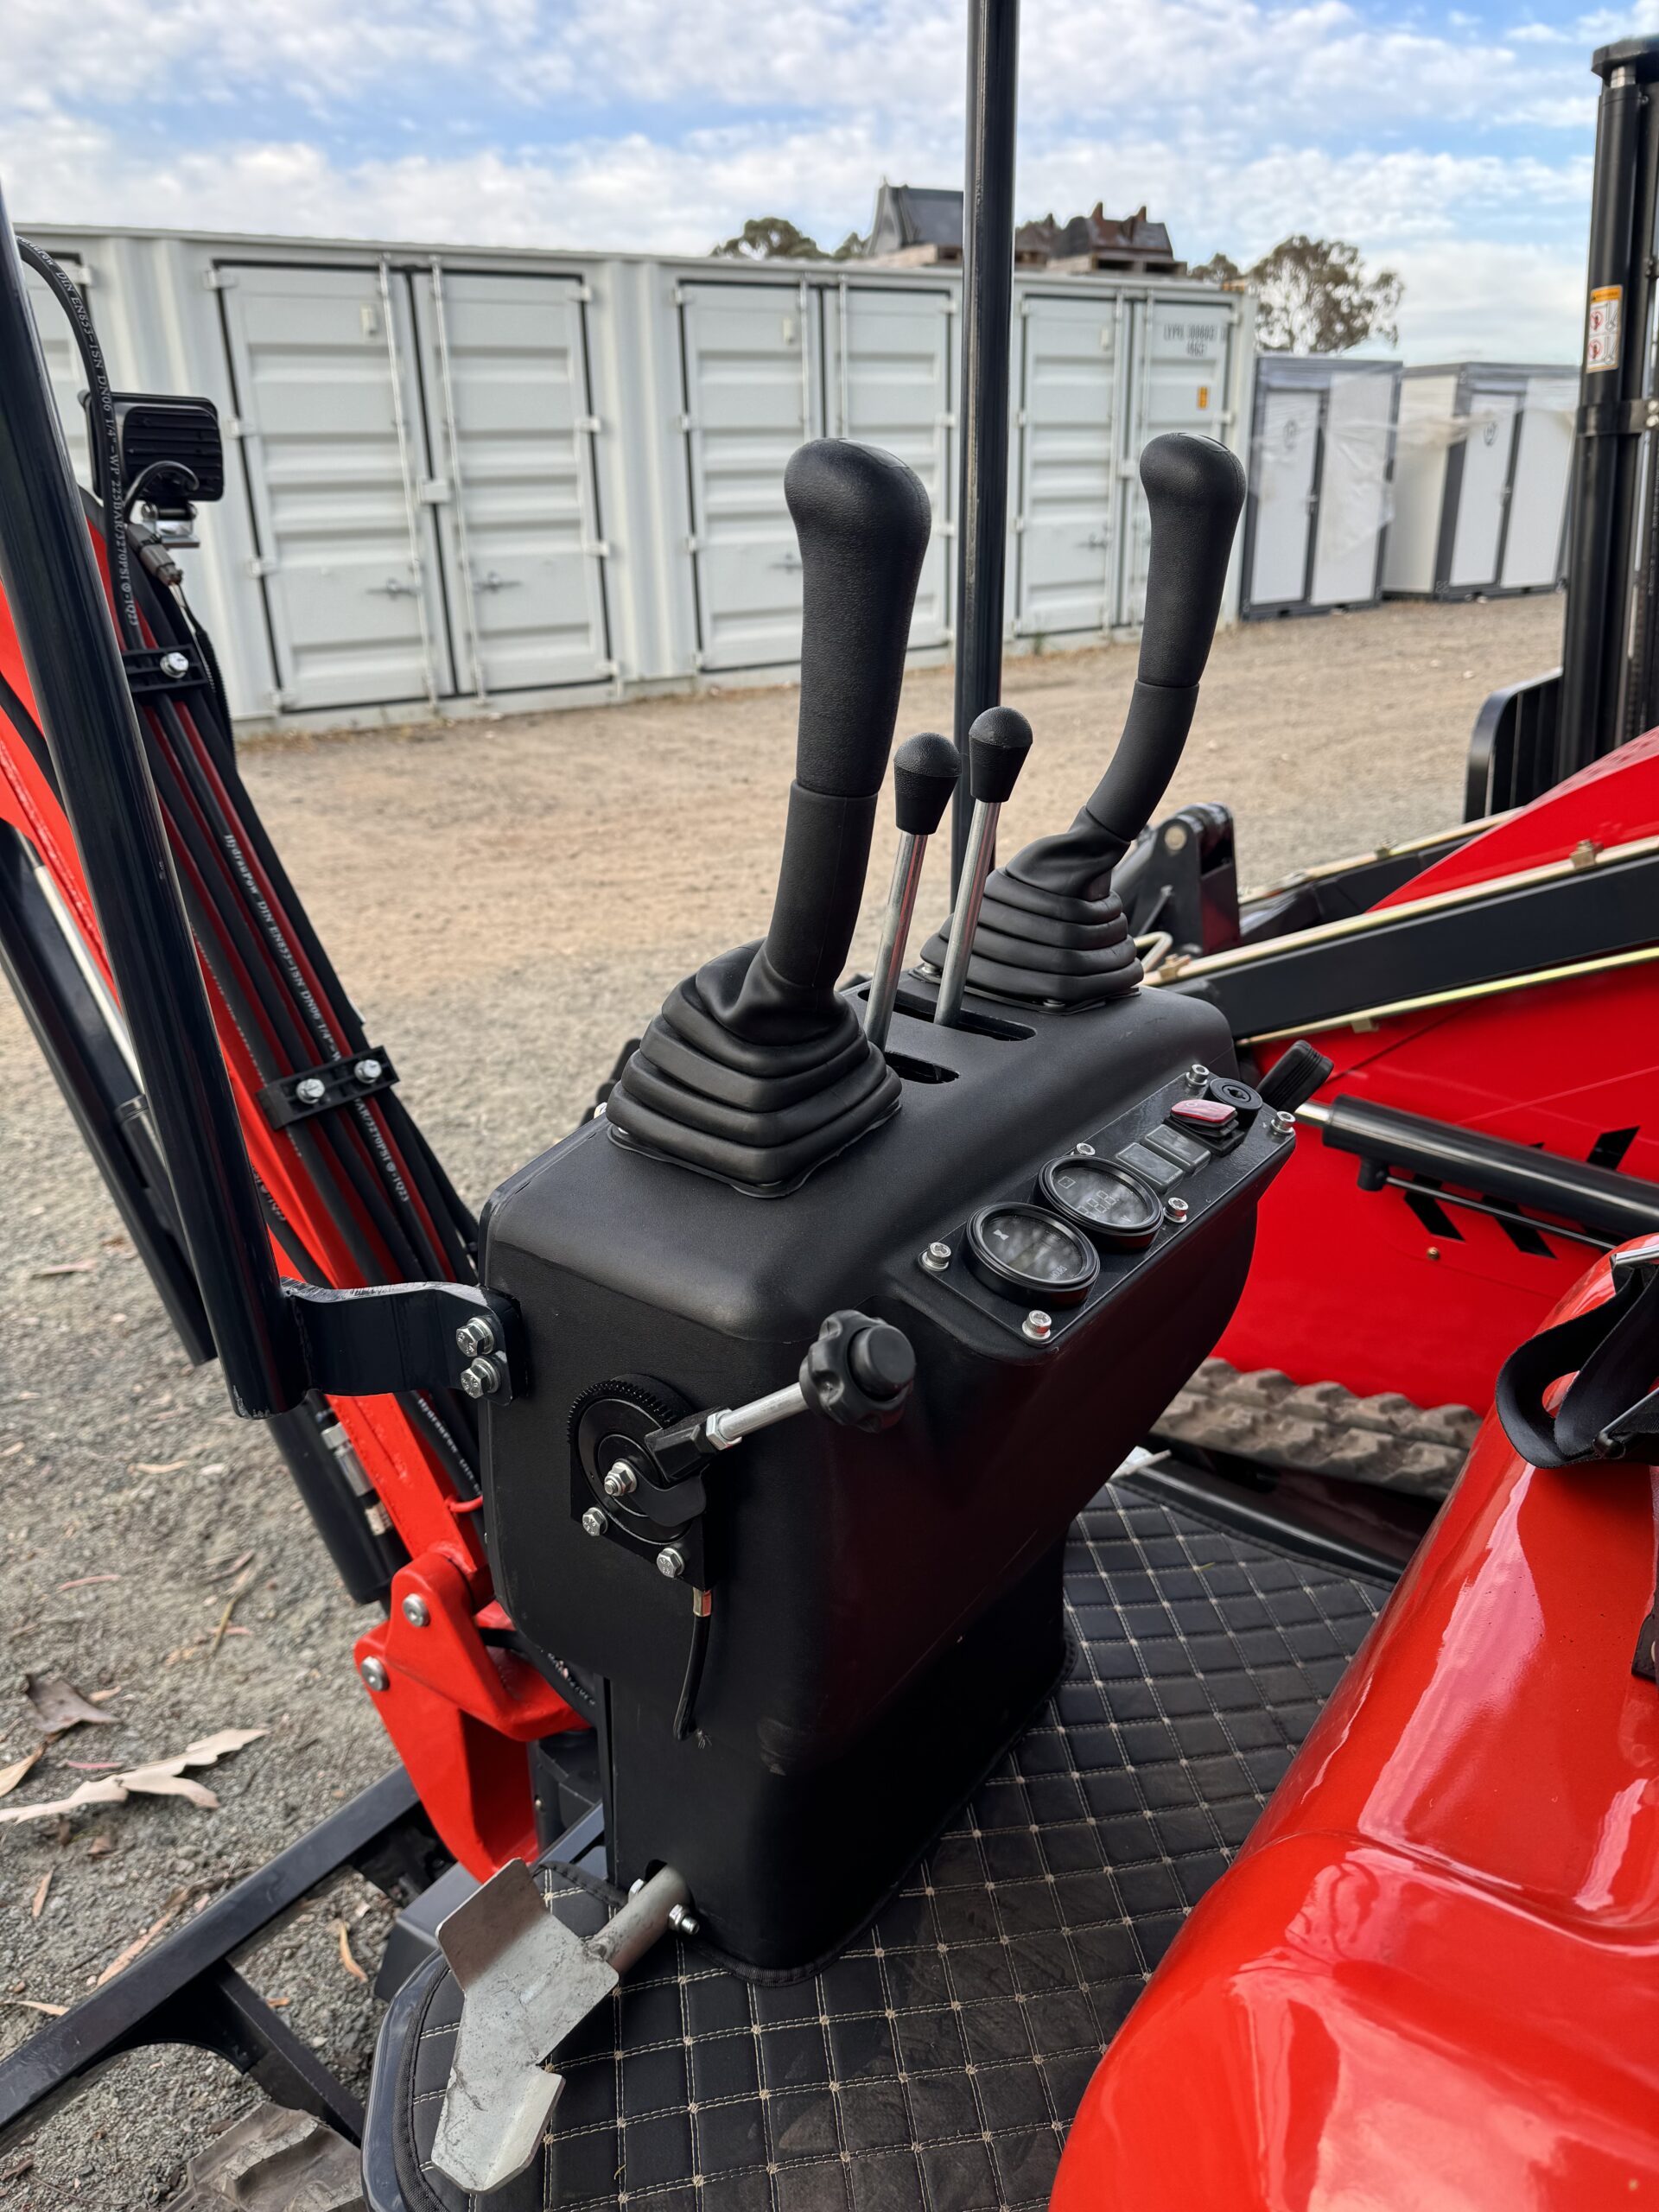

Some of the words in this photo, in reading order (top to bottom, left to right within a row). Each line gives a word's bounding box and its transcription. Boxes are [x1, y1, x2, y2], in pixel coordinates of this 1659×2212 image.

[56, 271, 74, 292] DIN
[97, 374, 112, 411] DN06
[257, 900, 274, 922] DIN
